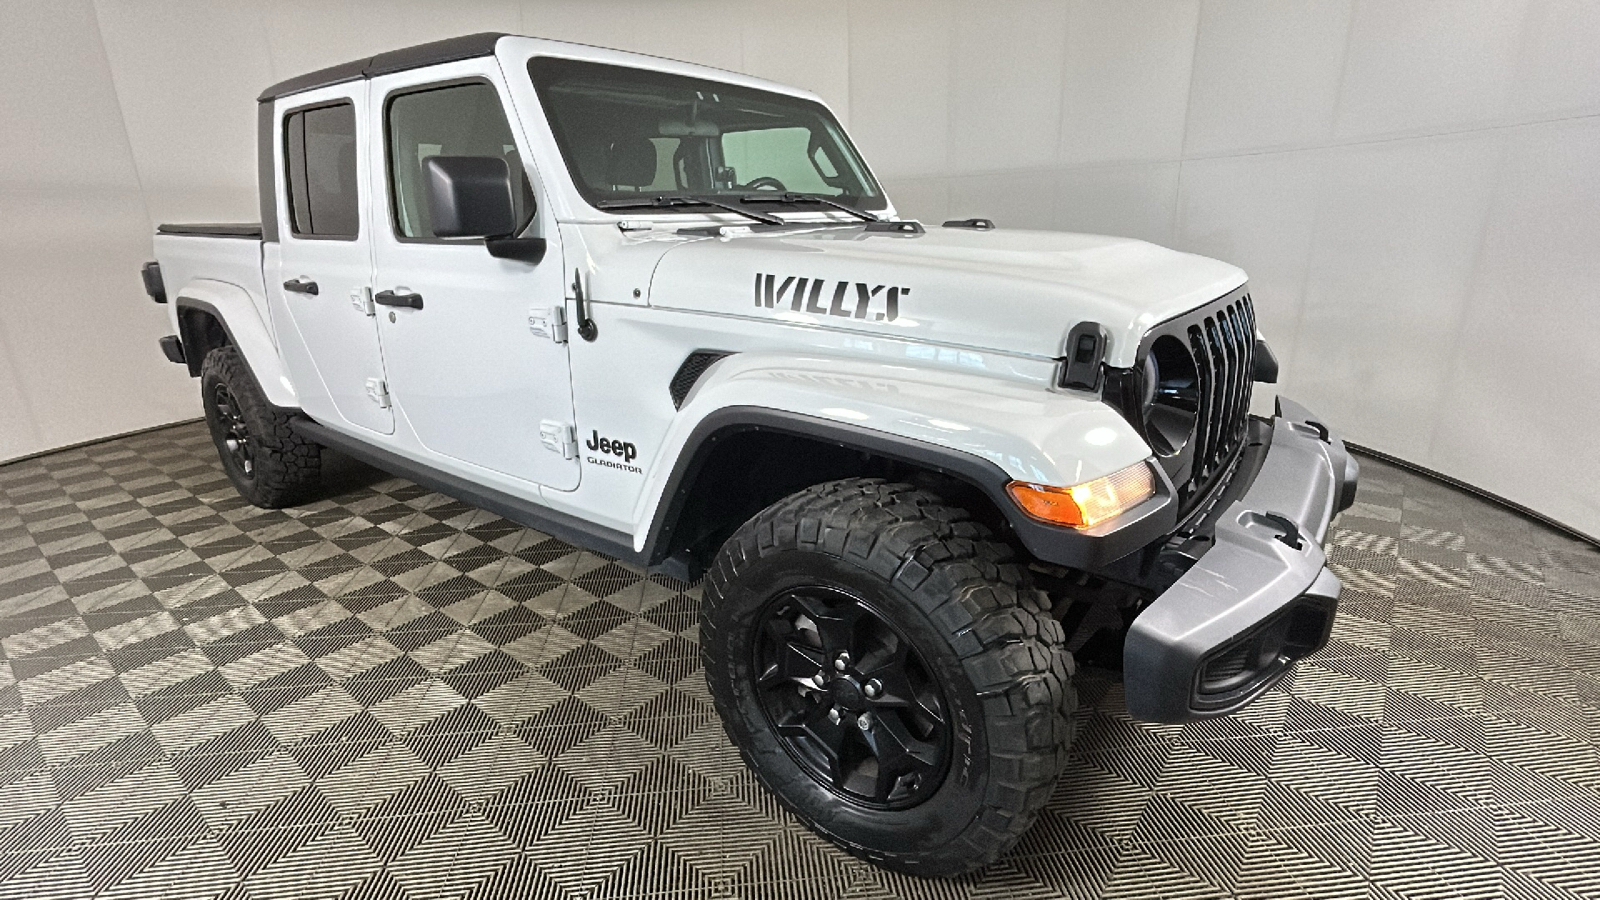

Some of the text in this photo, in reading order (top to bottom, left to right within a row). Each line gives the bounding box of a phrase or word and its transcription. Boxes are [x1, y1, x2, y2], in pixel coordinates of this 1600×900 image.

[755, 273, 911, 322] WILLYS
[587, 430, 637, 463] Jeep
[587, 457, 643, 475] GLADIATOR
